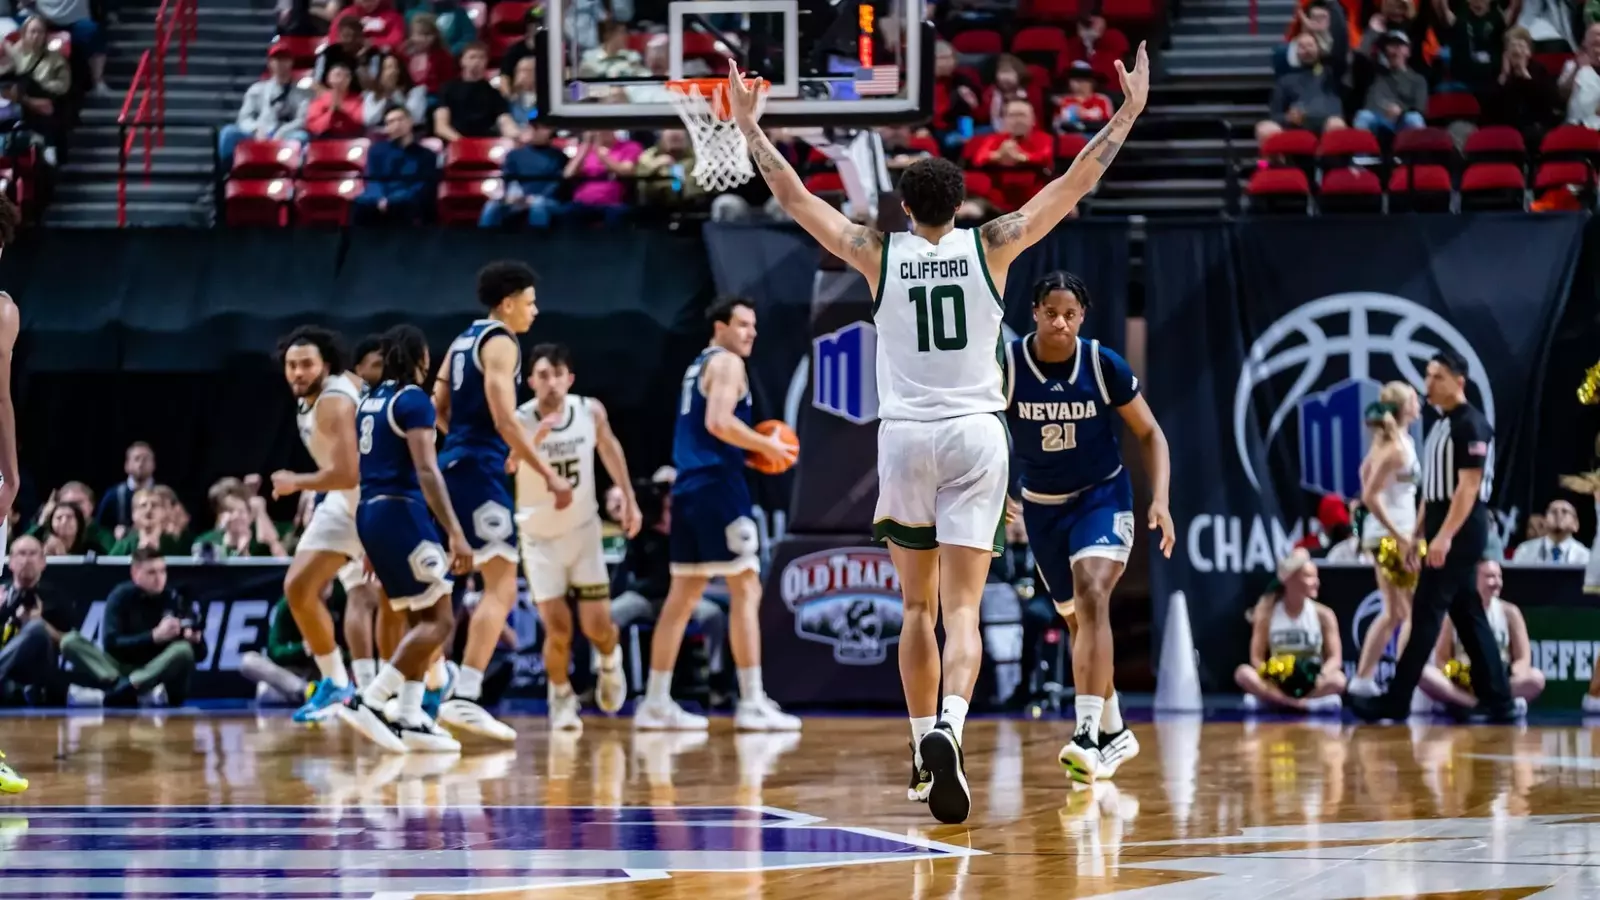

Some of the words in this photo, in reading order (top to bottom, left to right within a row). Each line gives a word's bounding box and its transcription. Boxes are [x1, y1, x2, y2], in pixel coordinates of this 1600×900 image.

[900, 258, 969, 280] CLIFFORD
[908, 284, 968, 352] 10
[1017, 400, 1097, 421] NEVADA
[360, 414, 375, 455] 3
[1041, 423, 1077, 452] 21
[781, 564, 830, 601] OLD
[830, 554, 900, 591] TRAP
